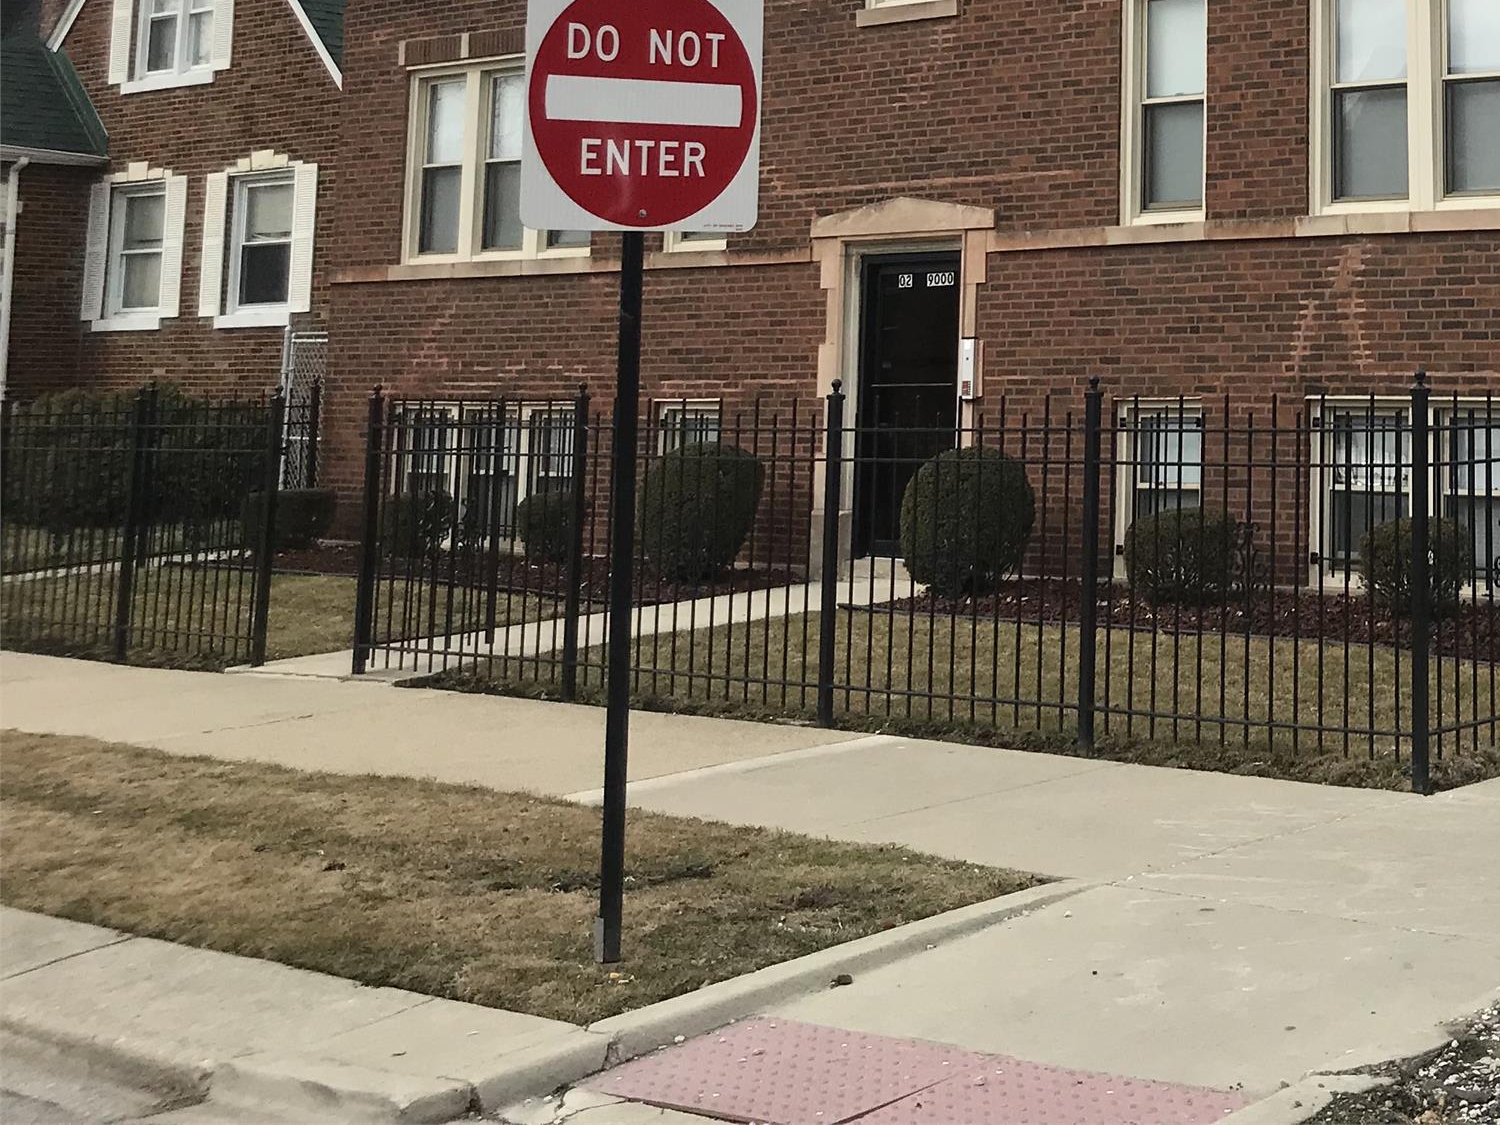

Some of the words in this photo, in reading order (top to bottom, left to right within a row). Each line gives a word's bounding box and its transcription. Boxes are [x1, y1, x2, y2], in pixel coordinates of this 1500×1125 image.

[566, 21, 620, 62] DO
[648, 28, 726, 69] NOT
[580, 137, 706, 178] ENTER
[899, 275, 912, 287] 02
[927, 272, 954, 286] 9000
